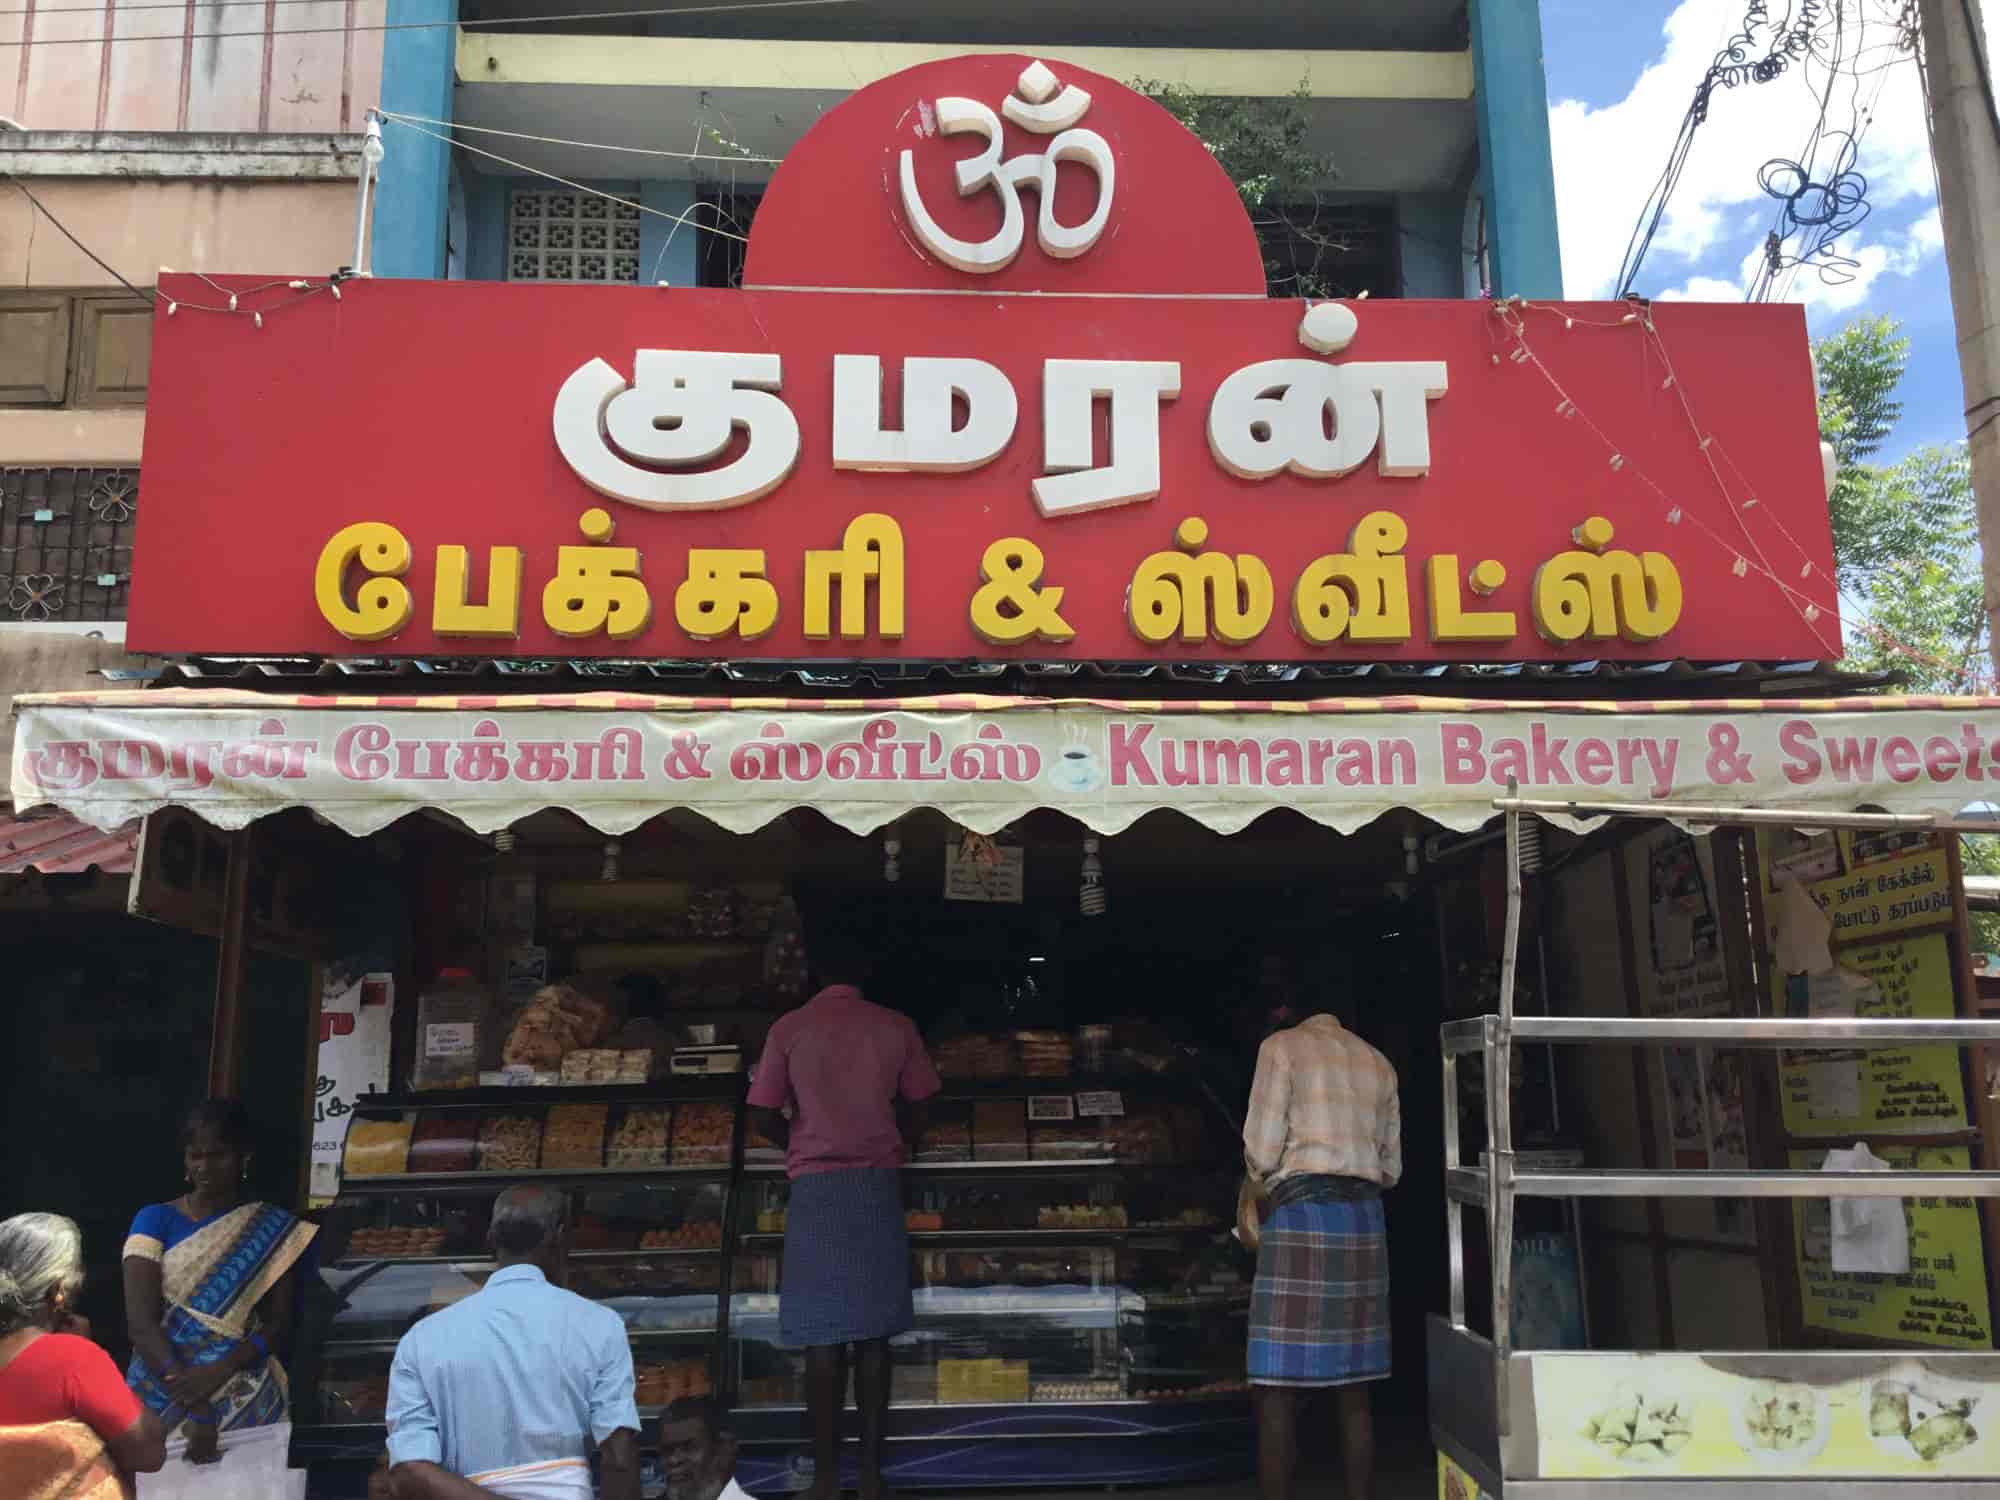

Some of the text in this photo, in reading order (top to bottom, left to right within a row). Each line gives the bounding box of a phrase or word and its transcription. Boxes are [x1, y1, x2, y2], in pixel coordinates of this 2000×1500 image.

[553, 302, 1448, 518] குமரன்
[314, 508, 1684, 645] பேக்கரி & ஸ்வீட்ஸ்
[23, 718, 1042, 788] குமரன் பேக்கரி & ஸ்வீட்ஸ்
[1109, 723, 1417, 786] Kumaran
[1441, 722, 1679, 799] Bakery
[1706, 722, 1755, 785] &
